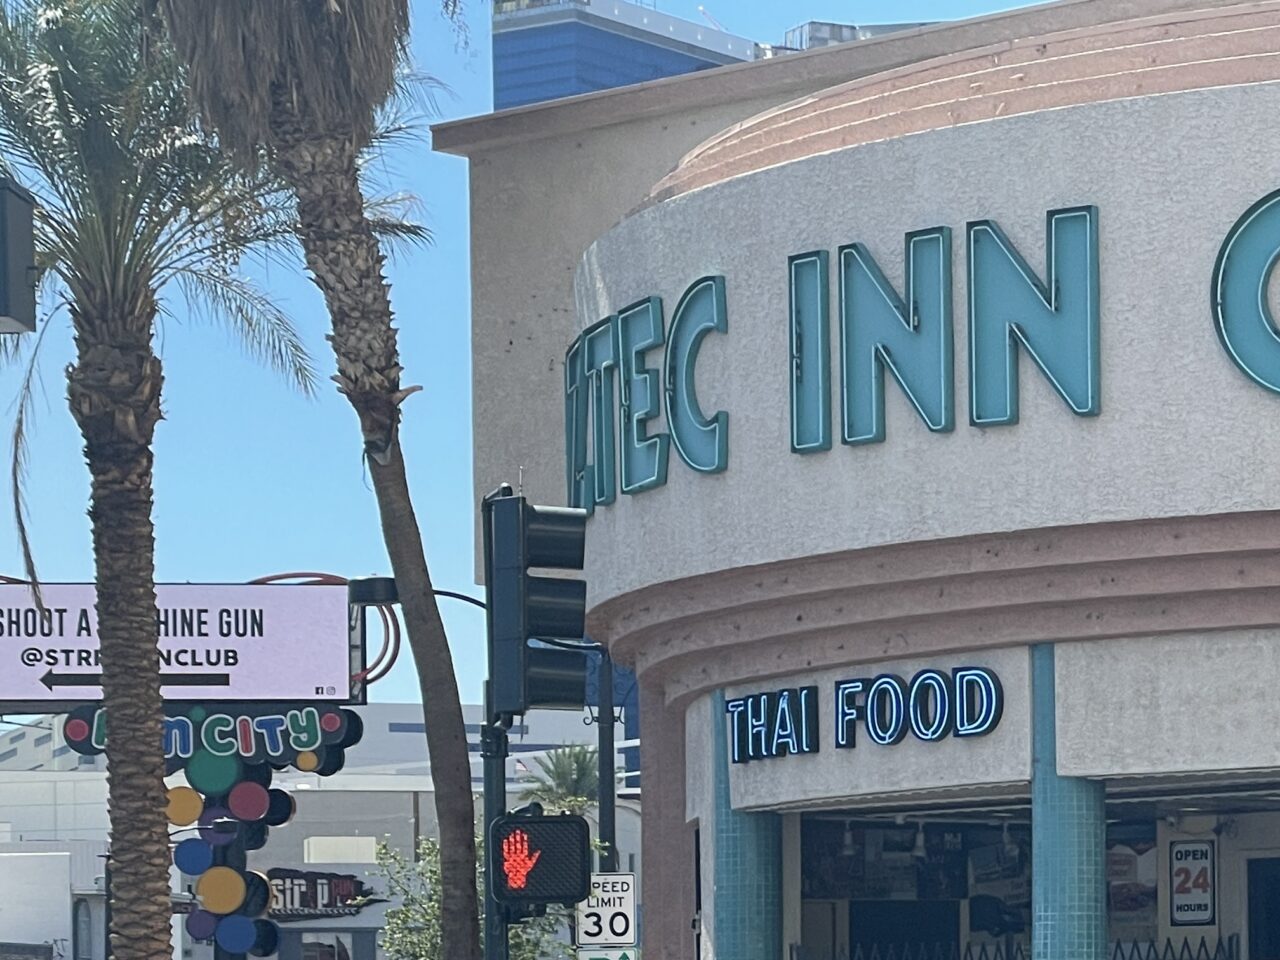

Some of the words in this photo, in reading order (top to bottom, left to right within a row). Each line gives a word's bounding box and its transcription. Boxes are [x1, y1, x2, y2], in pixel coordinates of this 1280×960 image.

[788, 205, 1100, 453] INN
[77, 608, 92, 637] A
[219, 608, 264, 637] GUN
[725, 685, 819, 764] THAI
[834, 666, 1004, 749] FOOD
[200, 707, 321, 757] CITY
[1175, 849, 1209, 861] OPEN
[592, 881, 630, 893] PEED
[1174, 866, 1210, 895] 24
[587, 896, 625, 908] LIMIT
[1176, 903, 1209, 912] HOURS
[584, 911, 630, 938] 30
